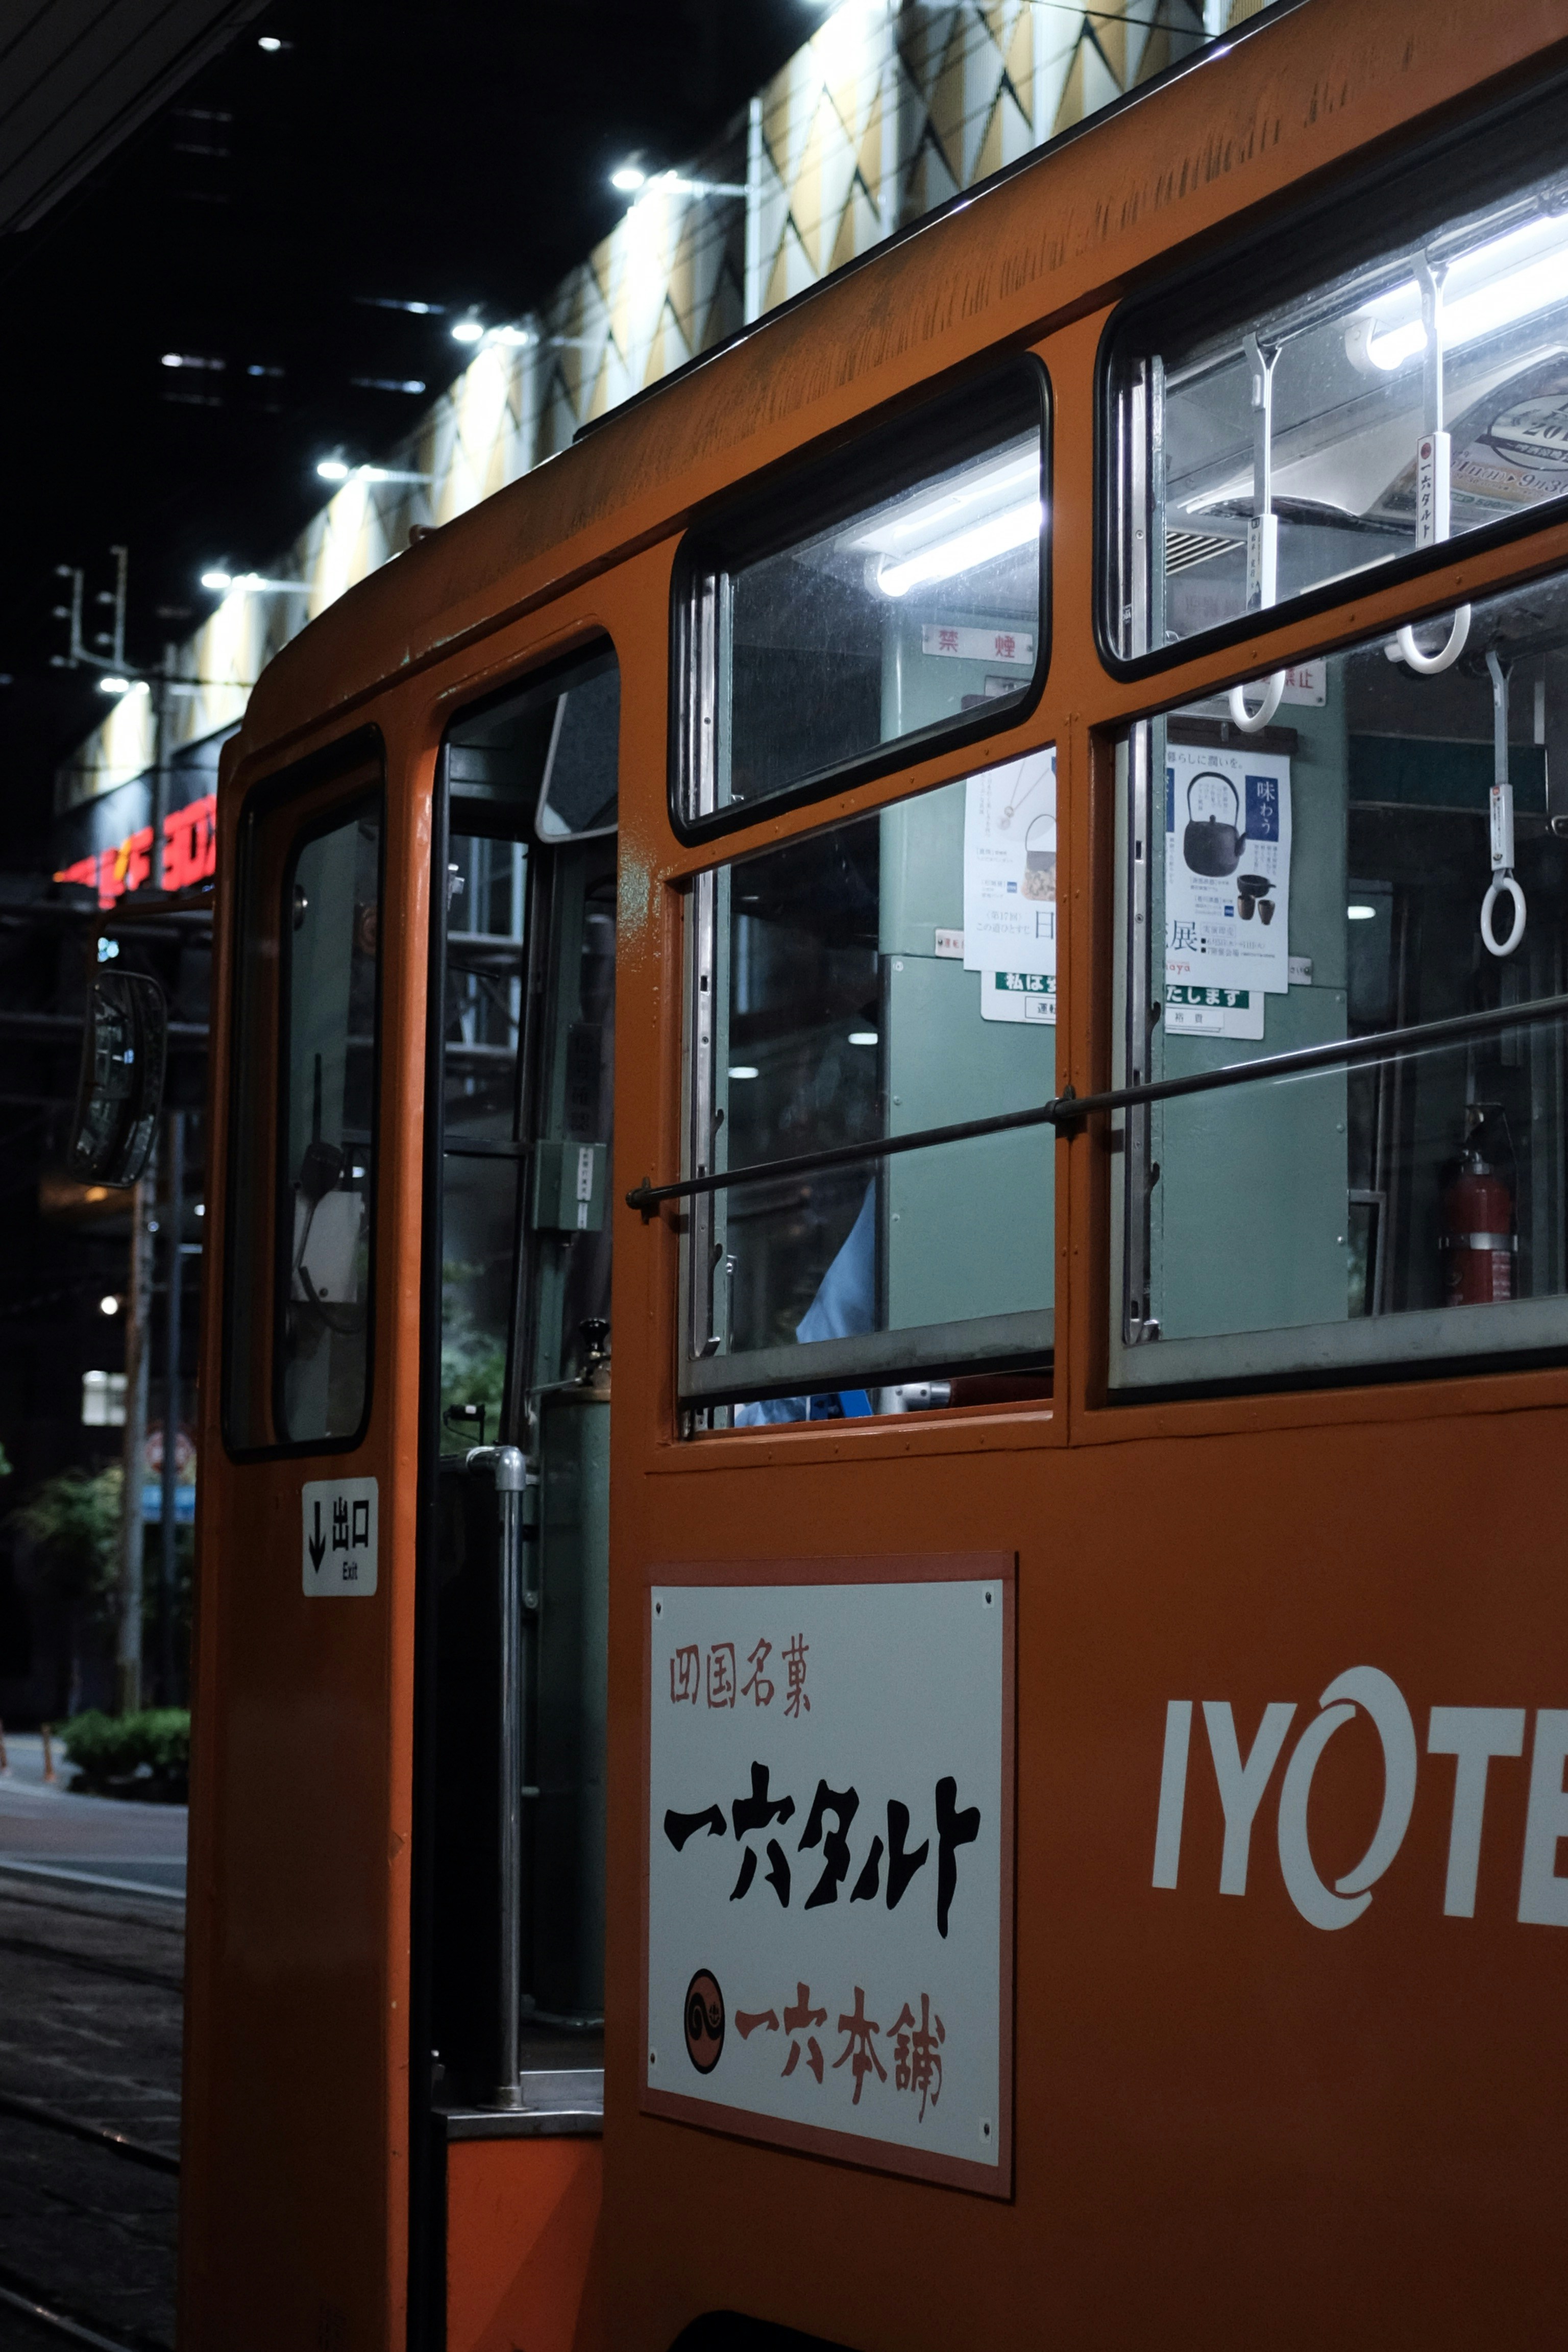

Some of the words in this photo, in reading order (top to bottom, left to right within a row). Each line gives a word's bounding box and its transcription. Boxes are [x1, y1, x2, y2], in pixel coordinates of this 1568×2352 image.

[1420, 463, 1431, 540] 一六タルト
[938, 629, 1015, 658] 禁煙
[1257, 781, 1276, 835] 味わう
[1171, 920, 1198, 952] 展
[1167, 985, 1240, 1007] たします
[333, 1497, 369, 1551] 出口
[342, 1560, 358, 1580] Exit
[669, 1633, 812, 1719] 四国名菓
[1152, 1665, 1568, 1930] IYOTE
[664, 1760, 982, 1939] 一六タルト
[734, 1982, 946, 2123] 一六本舗
